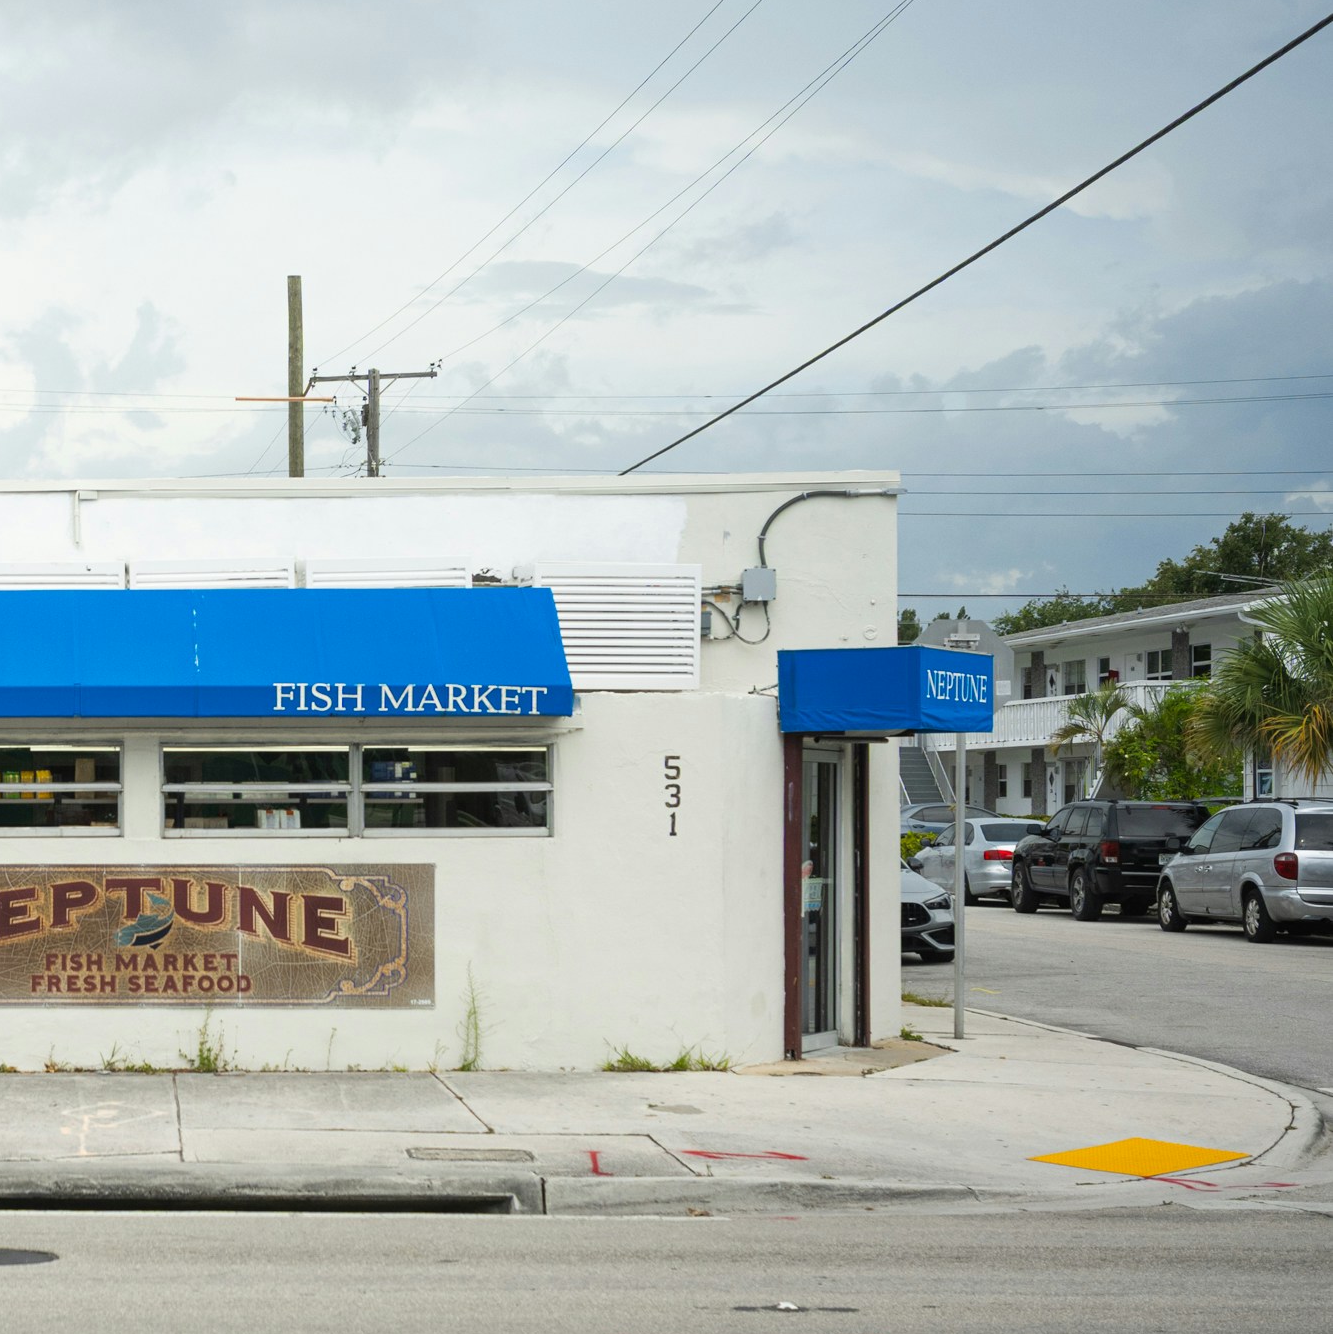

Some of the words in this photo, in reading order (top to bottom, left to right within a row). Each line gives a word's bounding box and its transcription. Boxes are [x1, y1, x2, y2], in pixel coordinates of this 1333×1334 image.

[273, 682, 365, 712] FISH
[378, 683, 547, 715] MARKET
[926, 669, 987, 704] NEPTUNE
[664, 755, 681, 837] 531
[45, 953, 103, 972] FISH
[115, 953, 238, 972] MARKET
[31, 974, 117, 993] FRESH
[128, 974, 252, 993] SEAFOOD
